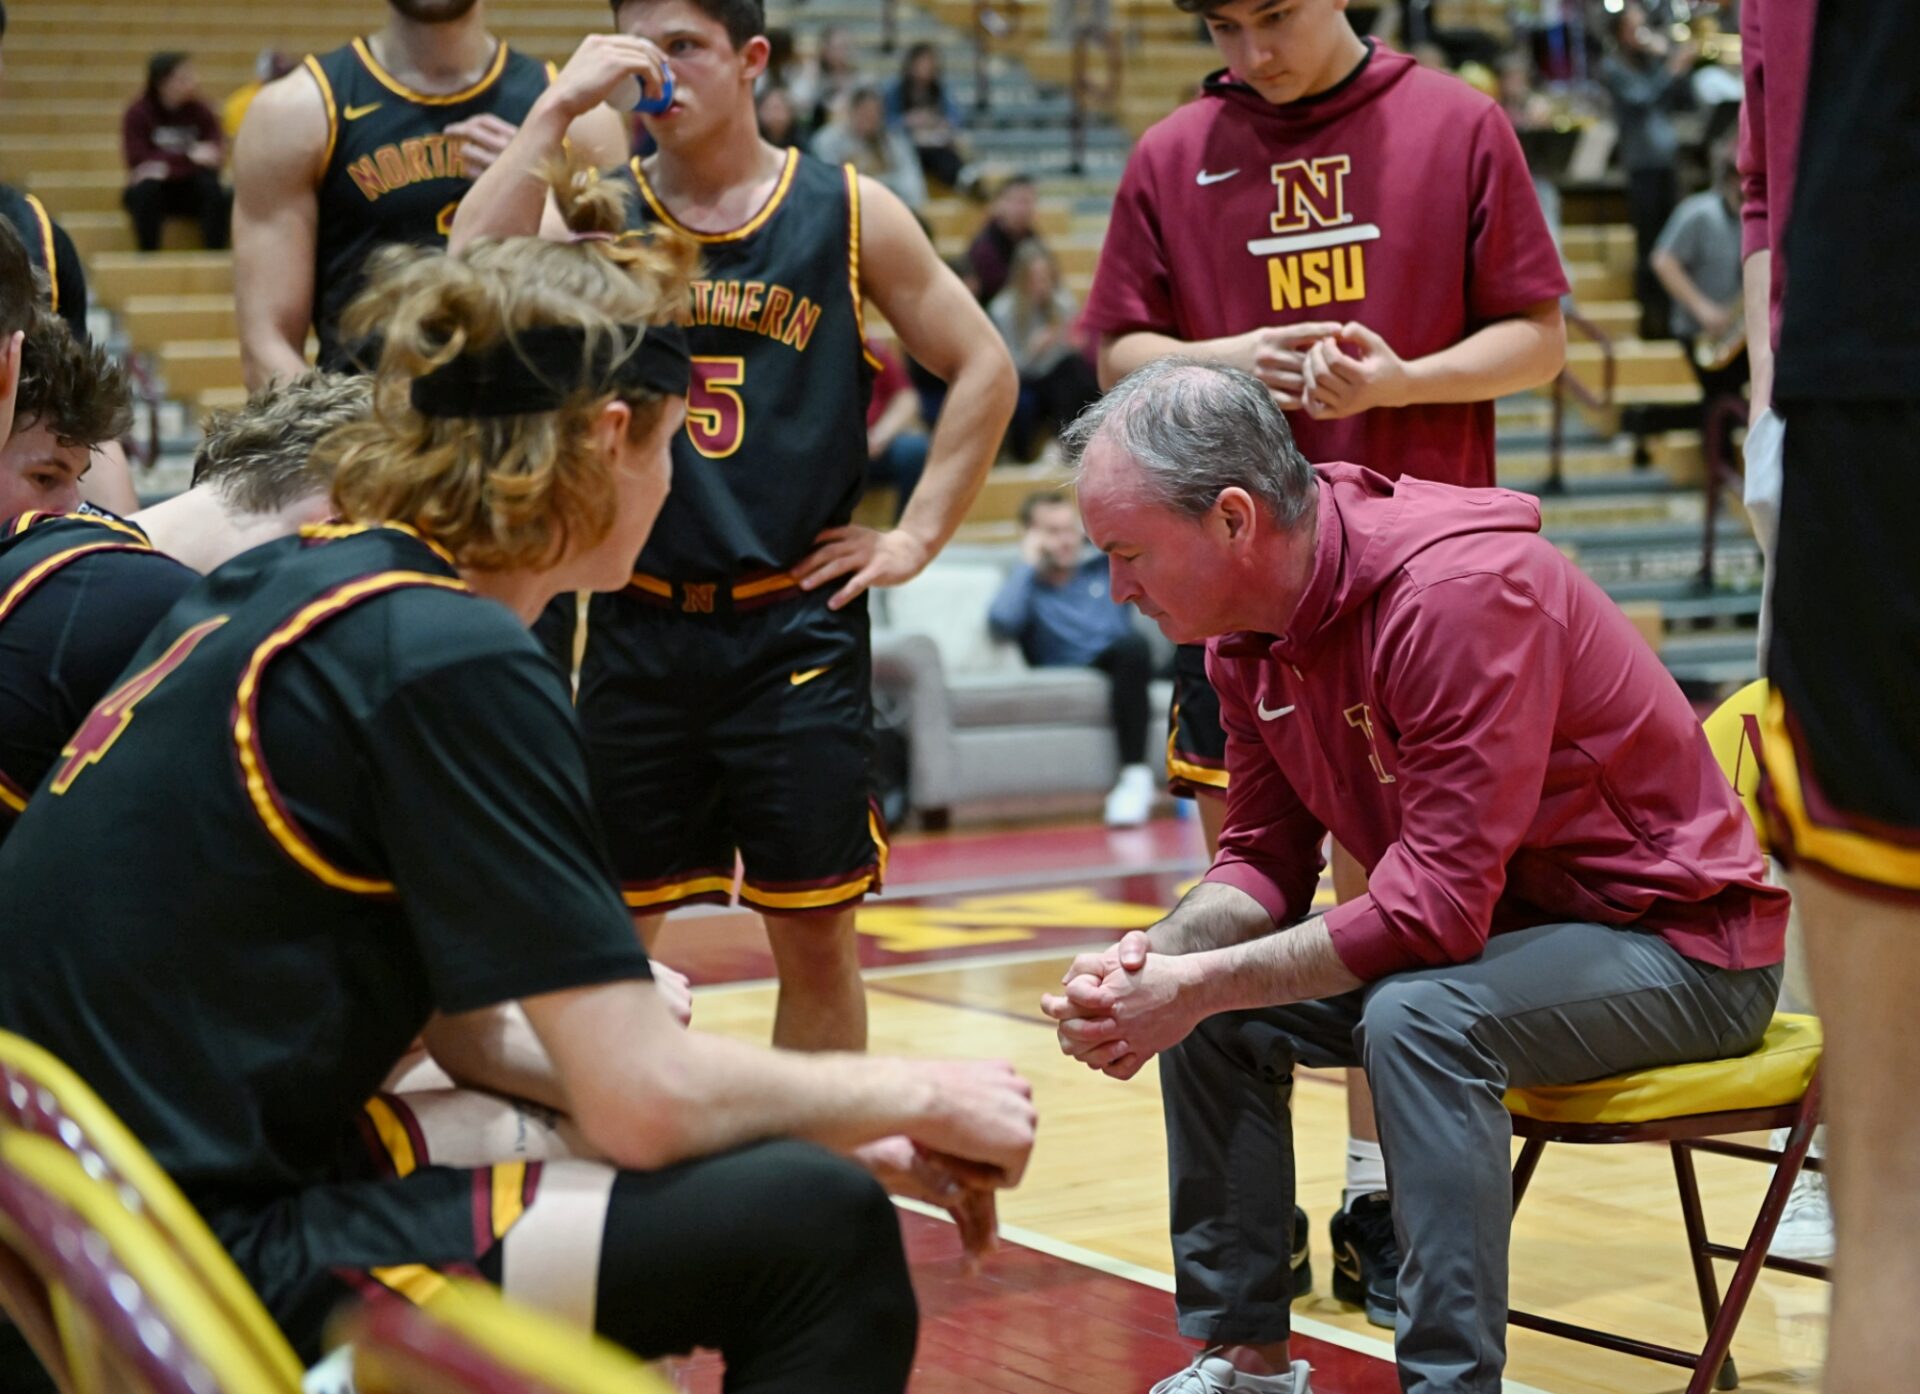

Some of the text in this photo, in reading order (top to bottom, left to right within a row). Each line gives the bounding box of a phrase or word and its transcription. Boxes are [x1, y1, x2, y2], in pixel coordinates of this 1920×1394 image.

[1271, 154, 1351, 233] N
[1268, 244, 1366, 311] NSU
[685, 354, 745, 459] 5
[682, 582, 717, 614] N
[49, 613, 231, 796] 4
